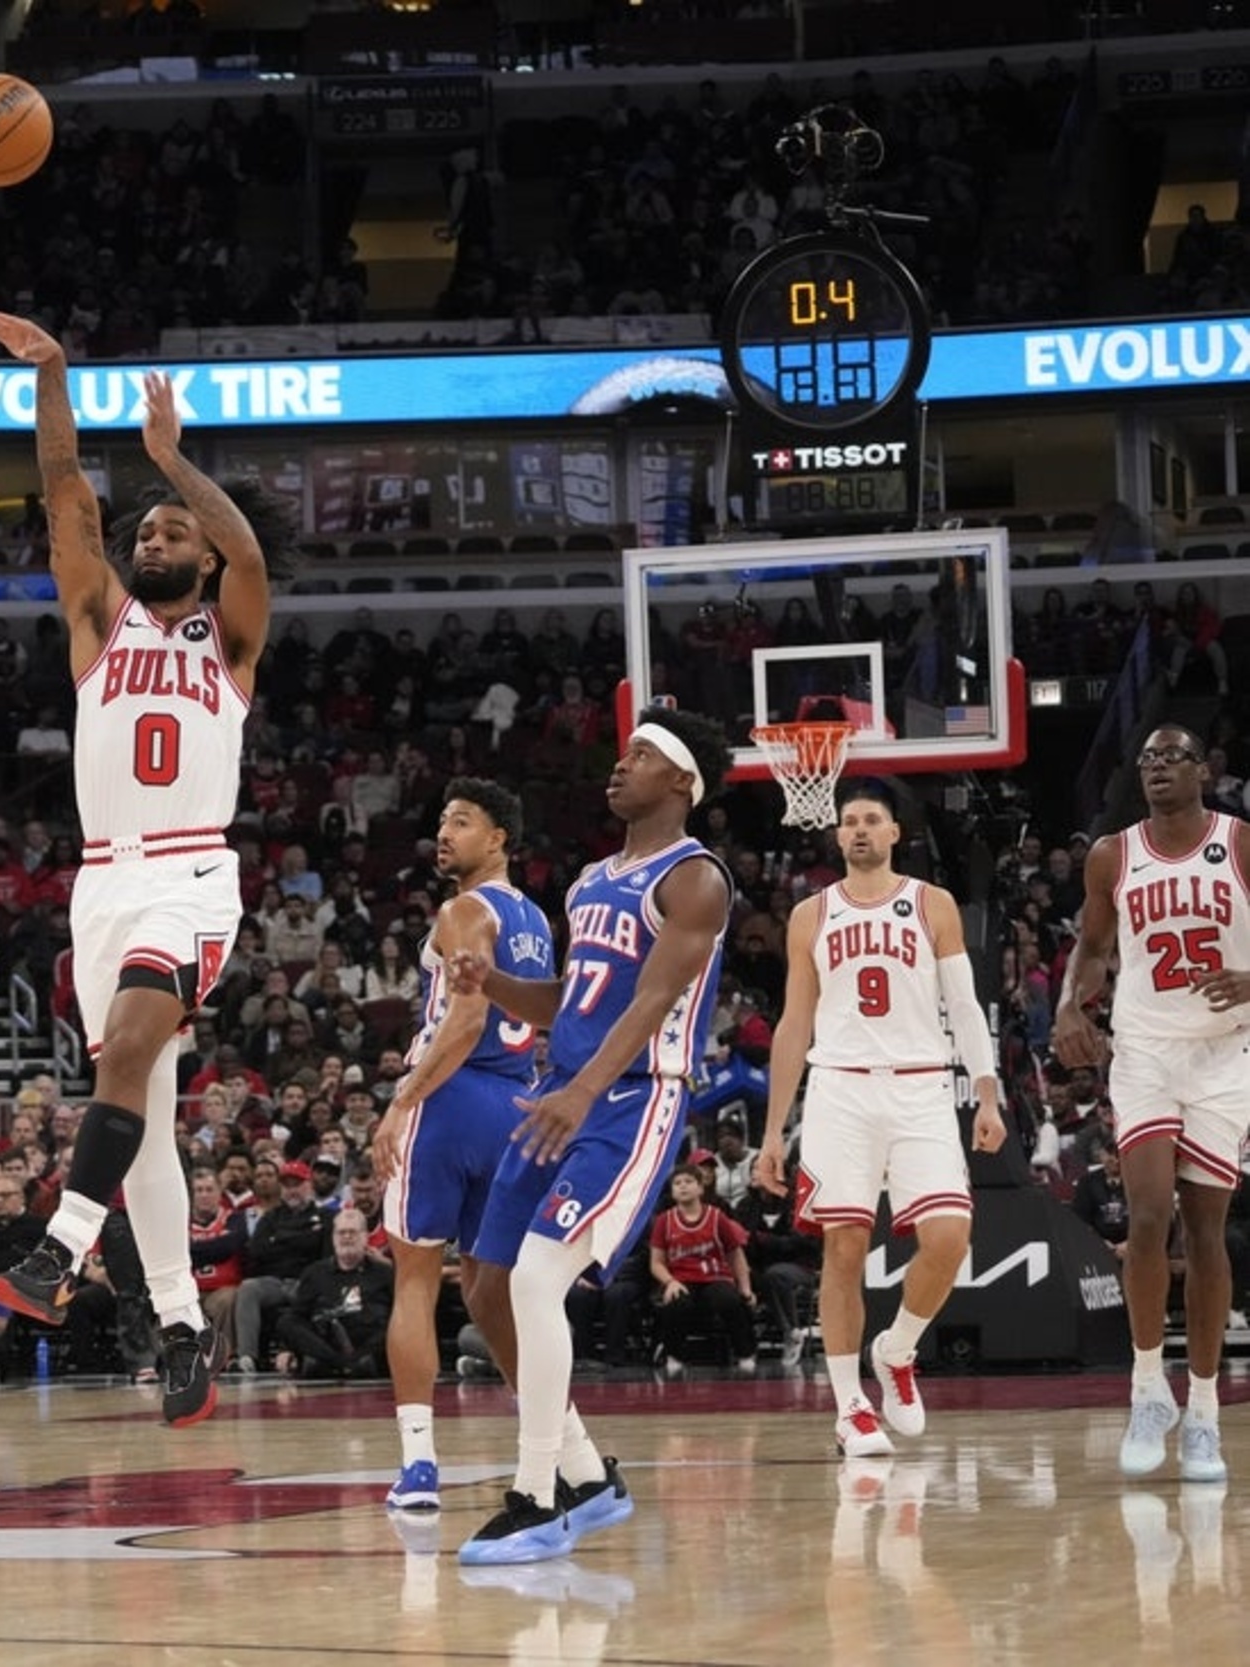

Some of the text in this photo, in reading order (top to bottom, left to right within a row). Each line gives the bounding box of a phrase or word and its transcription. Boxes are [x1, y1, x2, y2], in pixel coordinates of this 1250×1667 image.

[791, 280, 855, 324] 0.4
[211, 366, 341, 417] TIRE
[794, 442, 907, 469] TISSOT
[101, 647, 220, 716] BULLS
[133, 712, 181, 786] 0
[570, 903, 639, 959] HILA
[1127, 876, 1231, 936] BULLS
[827, 921, 916, 971] BULLS
[1146, 926, 1223, 992] 25
[858, 966, 890, 1017] 9
